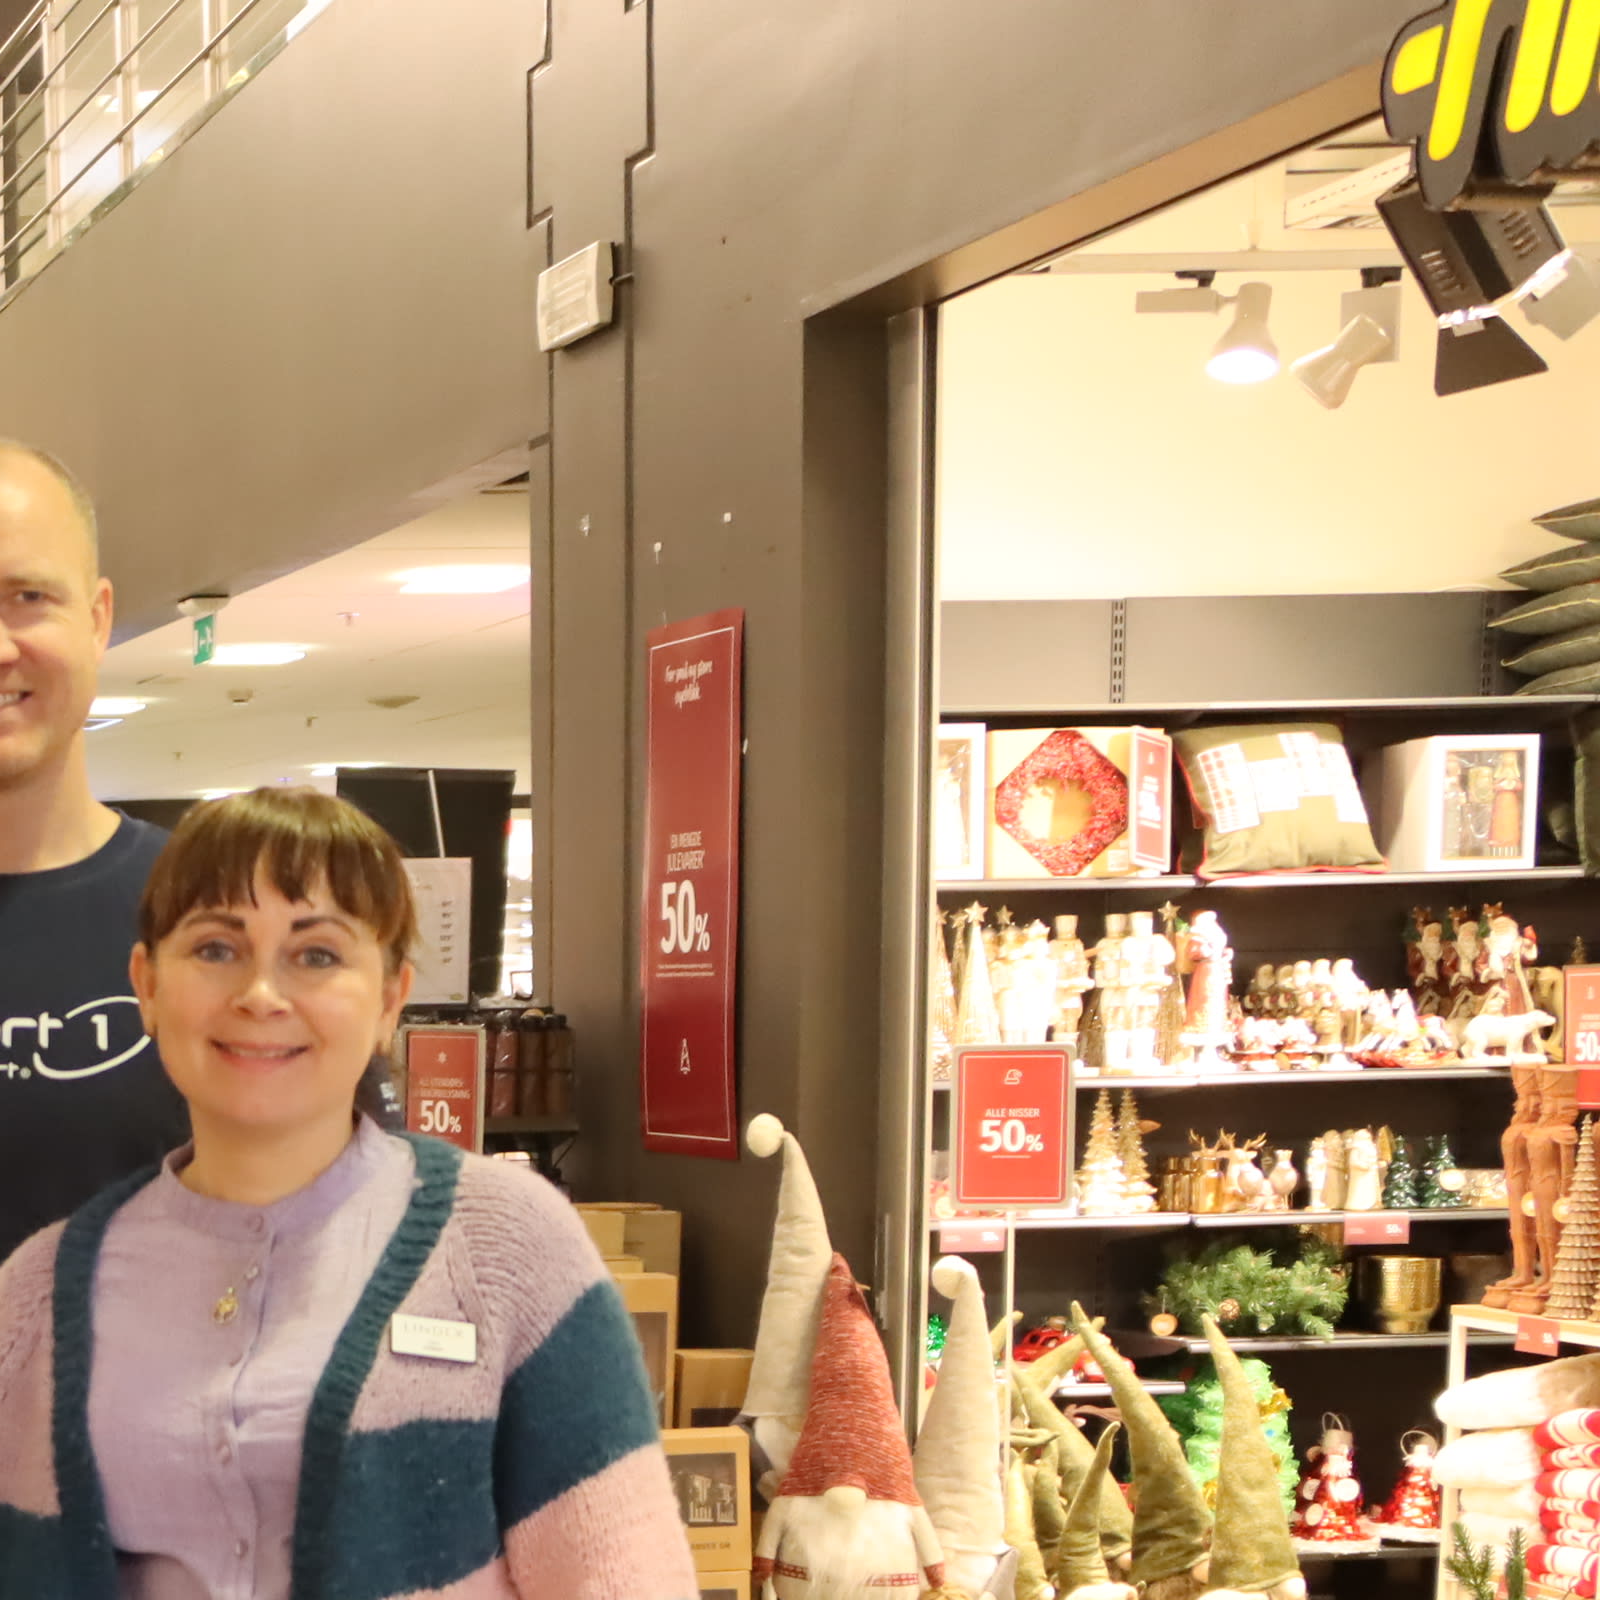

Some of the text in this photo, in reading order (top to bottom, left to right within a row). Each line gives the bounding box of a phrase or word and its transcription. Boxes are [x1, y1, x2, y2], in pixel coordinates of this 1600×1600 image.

[661, 879, 711, 954] 50%
[91, 1014, 109, 1050] 1
[1575, 1031, 1600, 1062] 50
[420, 1099, 462, 1133] 50%
[985, 1107, 1041, 1118] ALLE NISSER
[979, 1119, 1045, 1153] 50%
